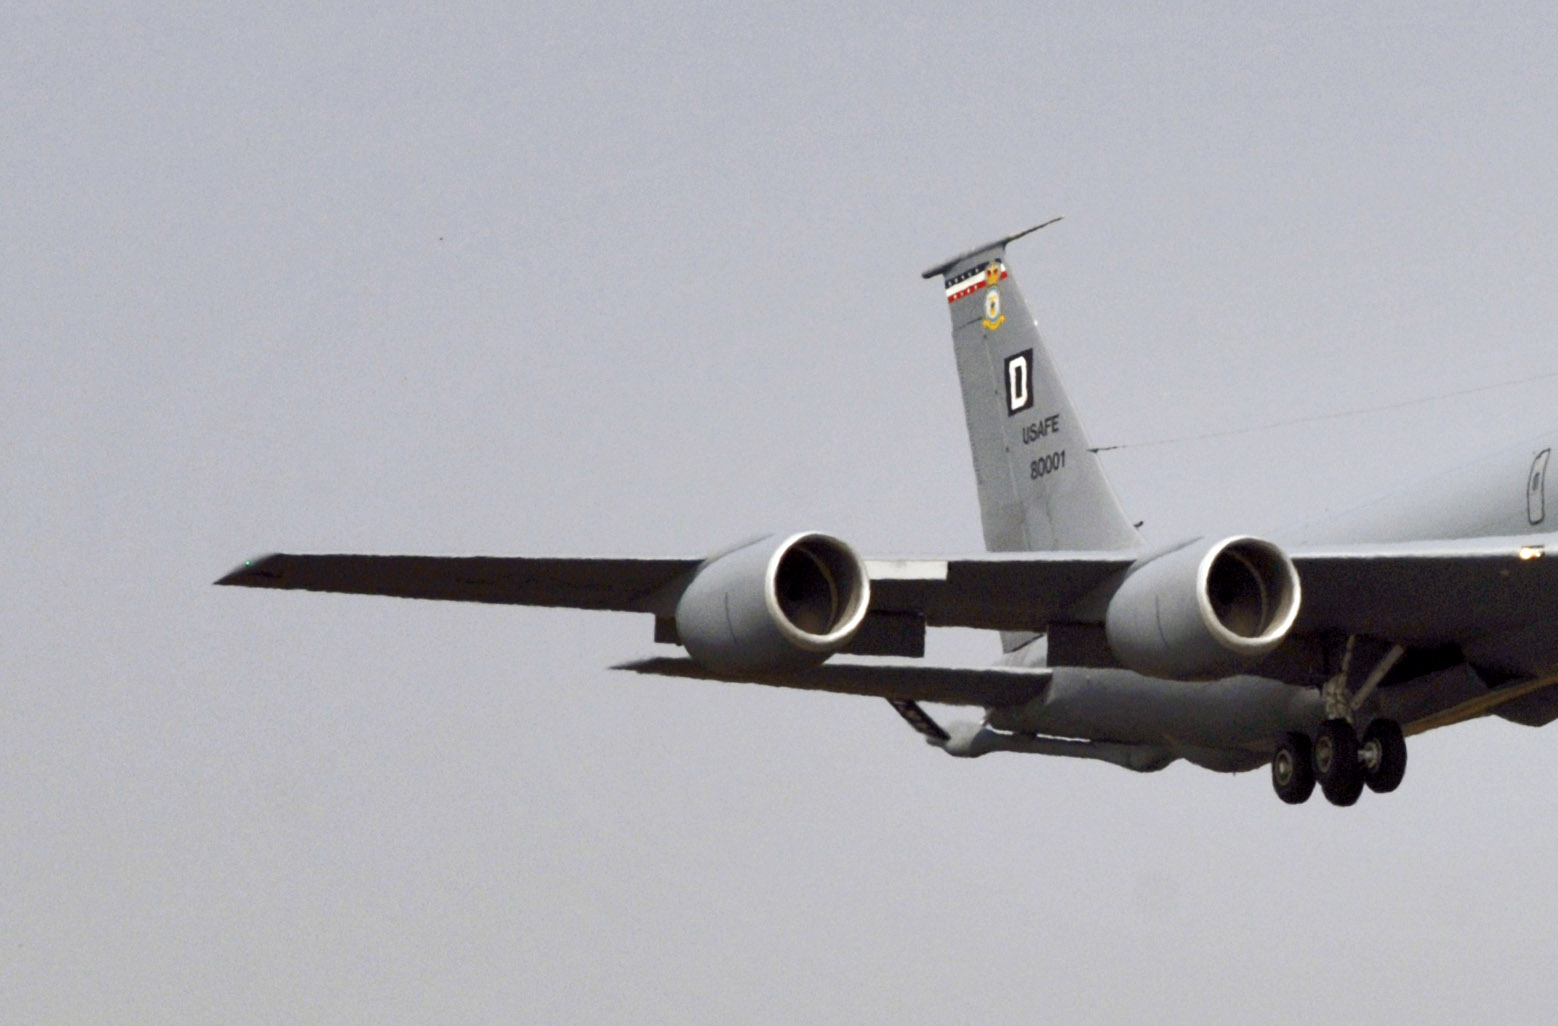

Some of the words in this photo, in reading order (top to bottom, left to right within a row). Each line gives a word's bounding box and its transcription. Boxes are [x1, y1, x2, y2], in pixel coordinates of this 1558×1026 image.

[1008, 355, 1028, 411] D
[1022, 413, 1061, 445] USAFE
[1030, 450, 1066, 480] 80001
